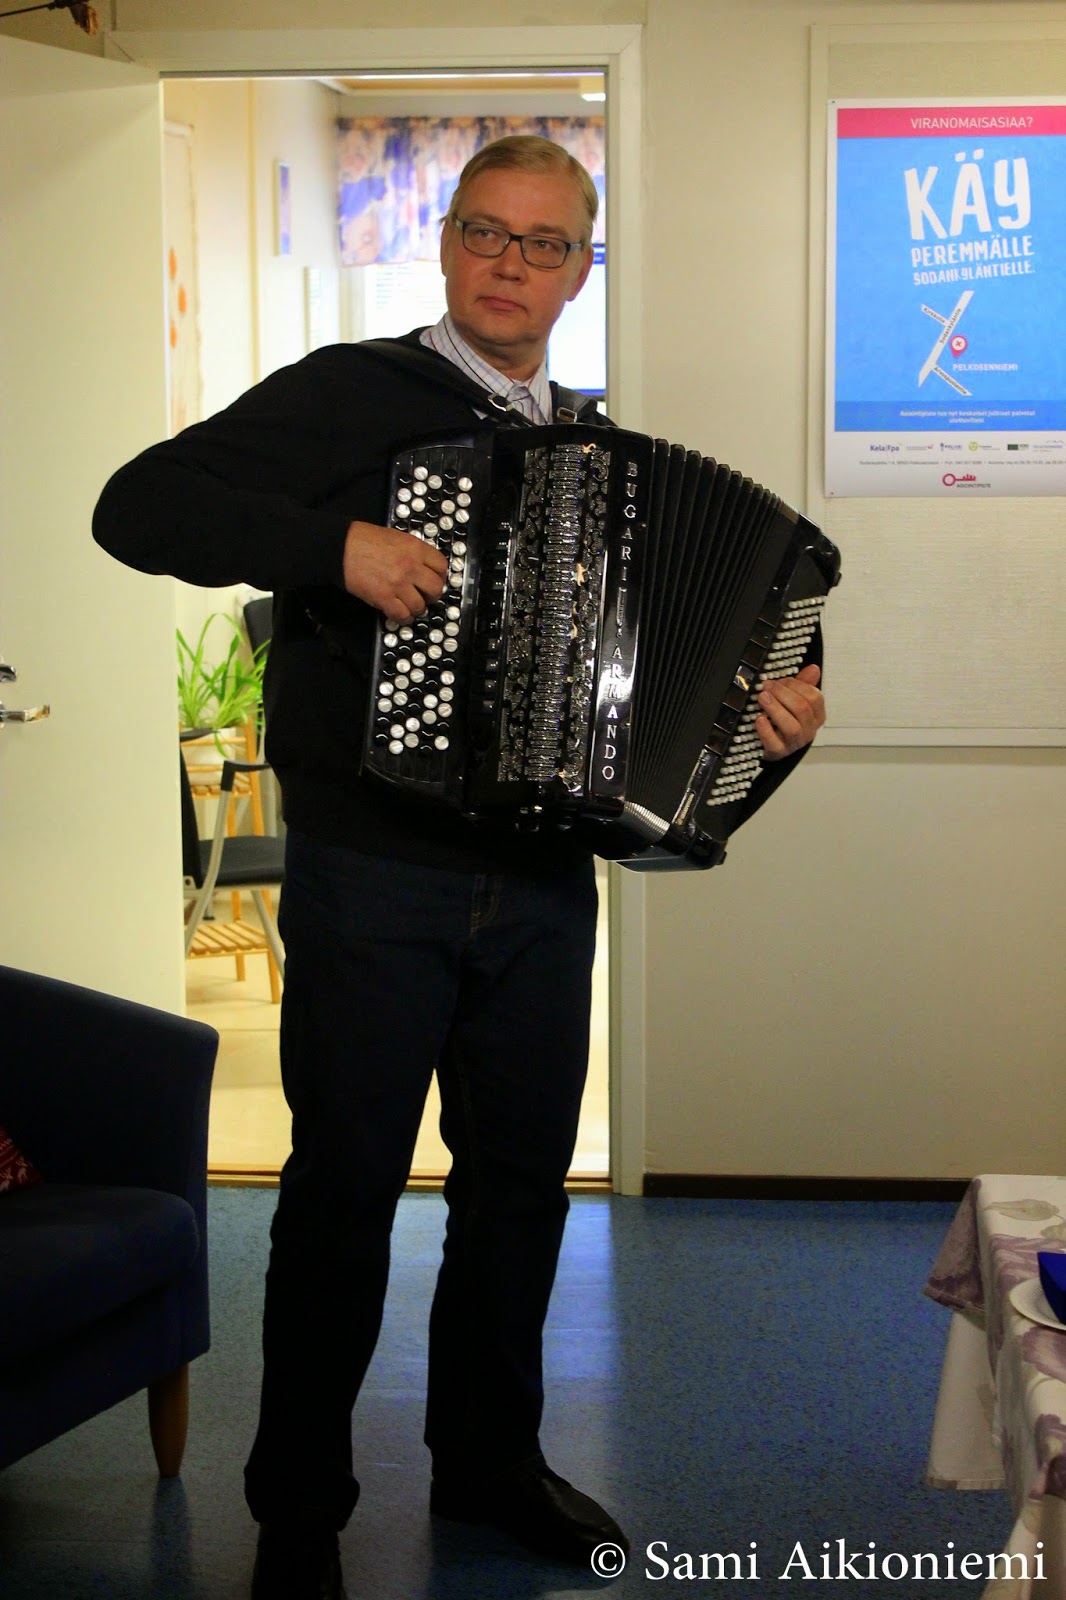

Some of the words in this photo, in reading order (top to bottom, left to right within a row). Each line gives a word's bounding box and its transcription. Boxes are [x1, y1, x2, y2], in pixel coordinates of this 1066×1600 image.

[910, 116, 1034, 129] VIRANOMAISASIAA?
[904, 148, 1031, 240] KÄY
[911, 235, 1035, 268] PEREMMÄLLE
[952, 363, 1018, 371] PELKOSENNIEMI
[621, 461, 638, 581] BUGARI
[602, 645, 623, 780] ARMANDO
